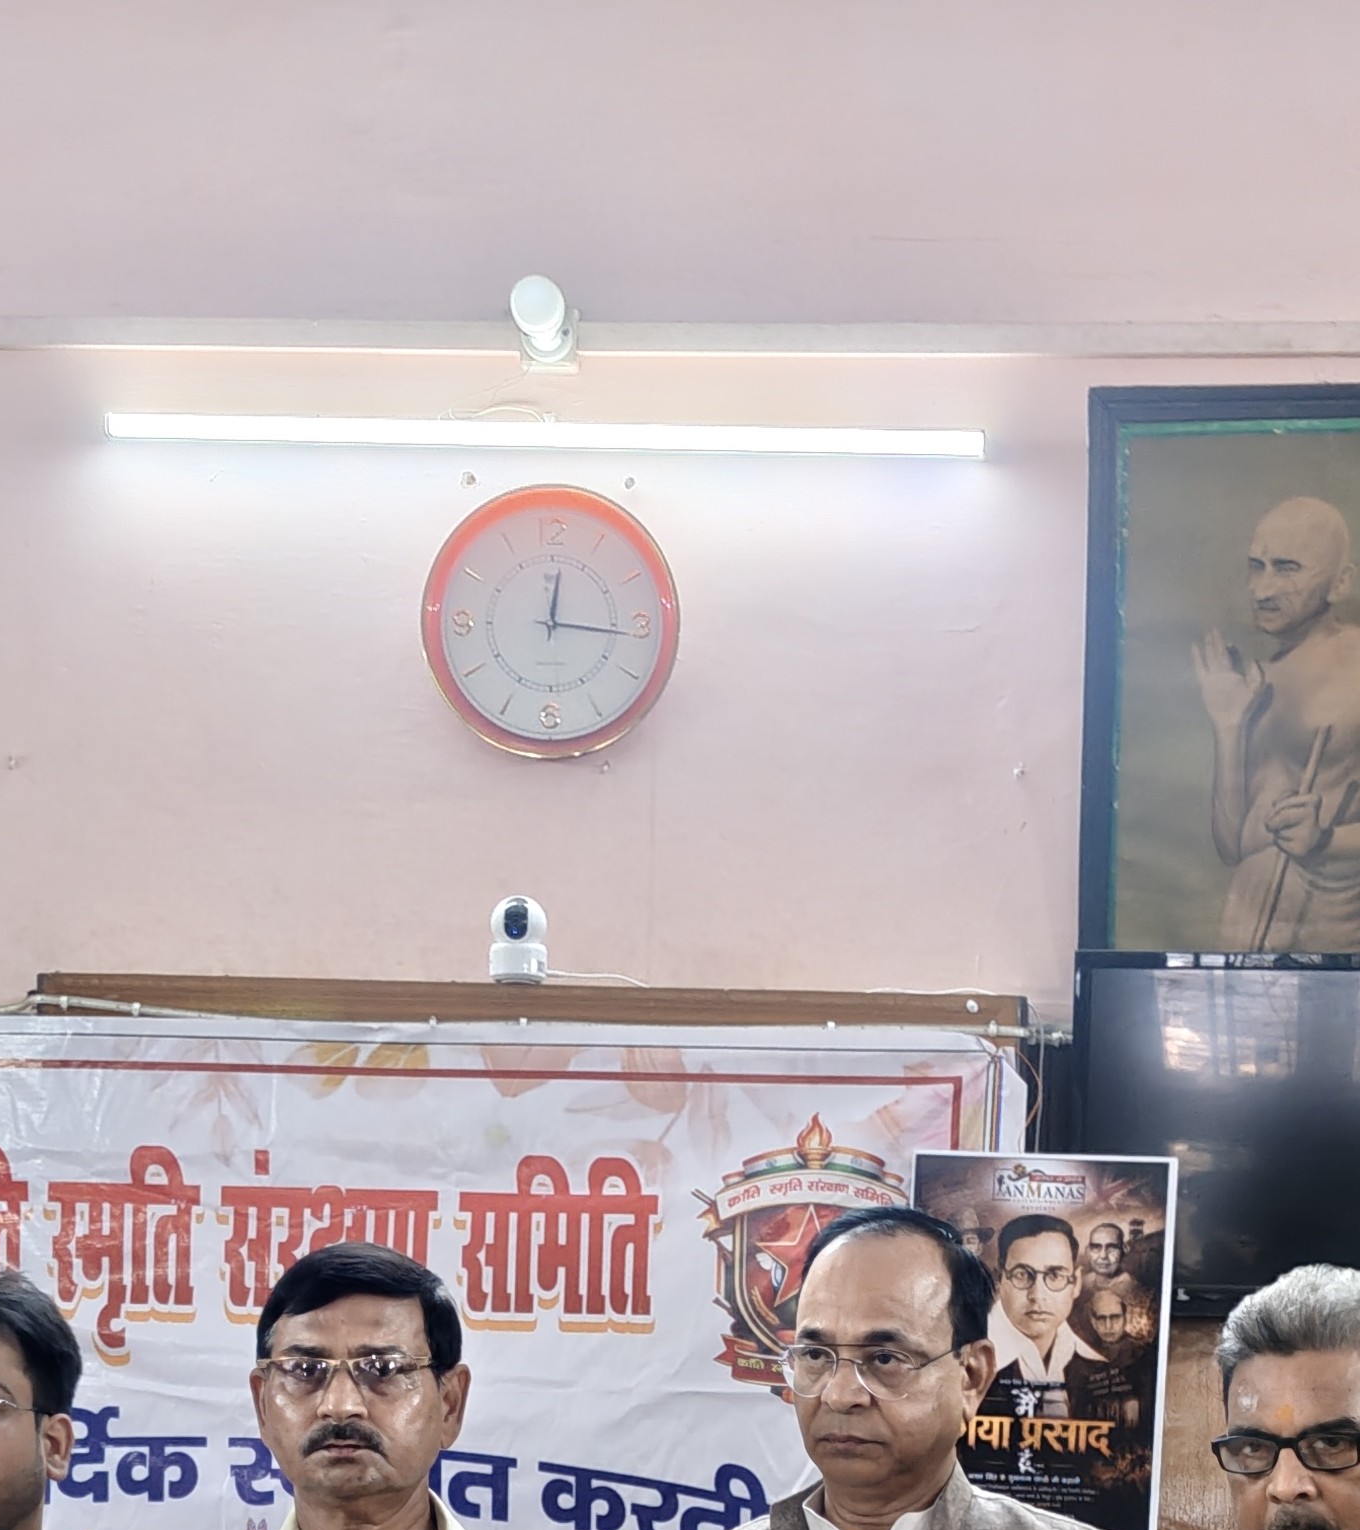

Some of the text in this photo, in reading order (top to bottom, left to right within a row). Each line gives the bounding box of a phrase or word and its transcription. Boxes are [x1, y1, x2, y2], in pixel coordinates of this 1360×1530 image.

[453, 609, 474, 637] 9
[539, 703, 561, 729] 6
[48, 1145, 202, 1350] स्मृति
[459, 1155, 658, 1316] समिति
[1019, 1418, 1116, 1460] प्रसाद
